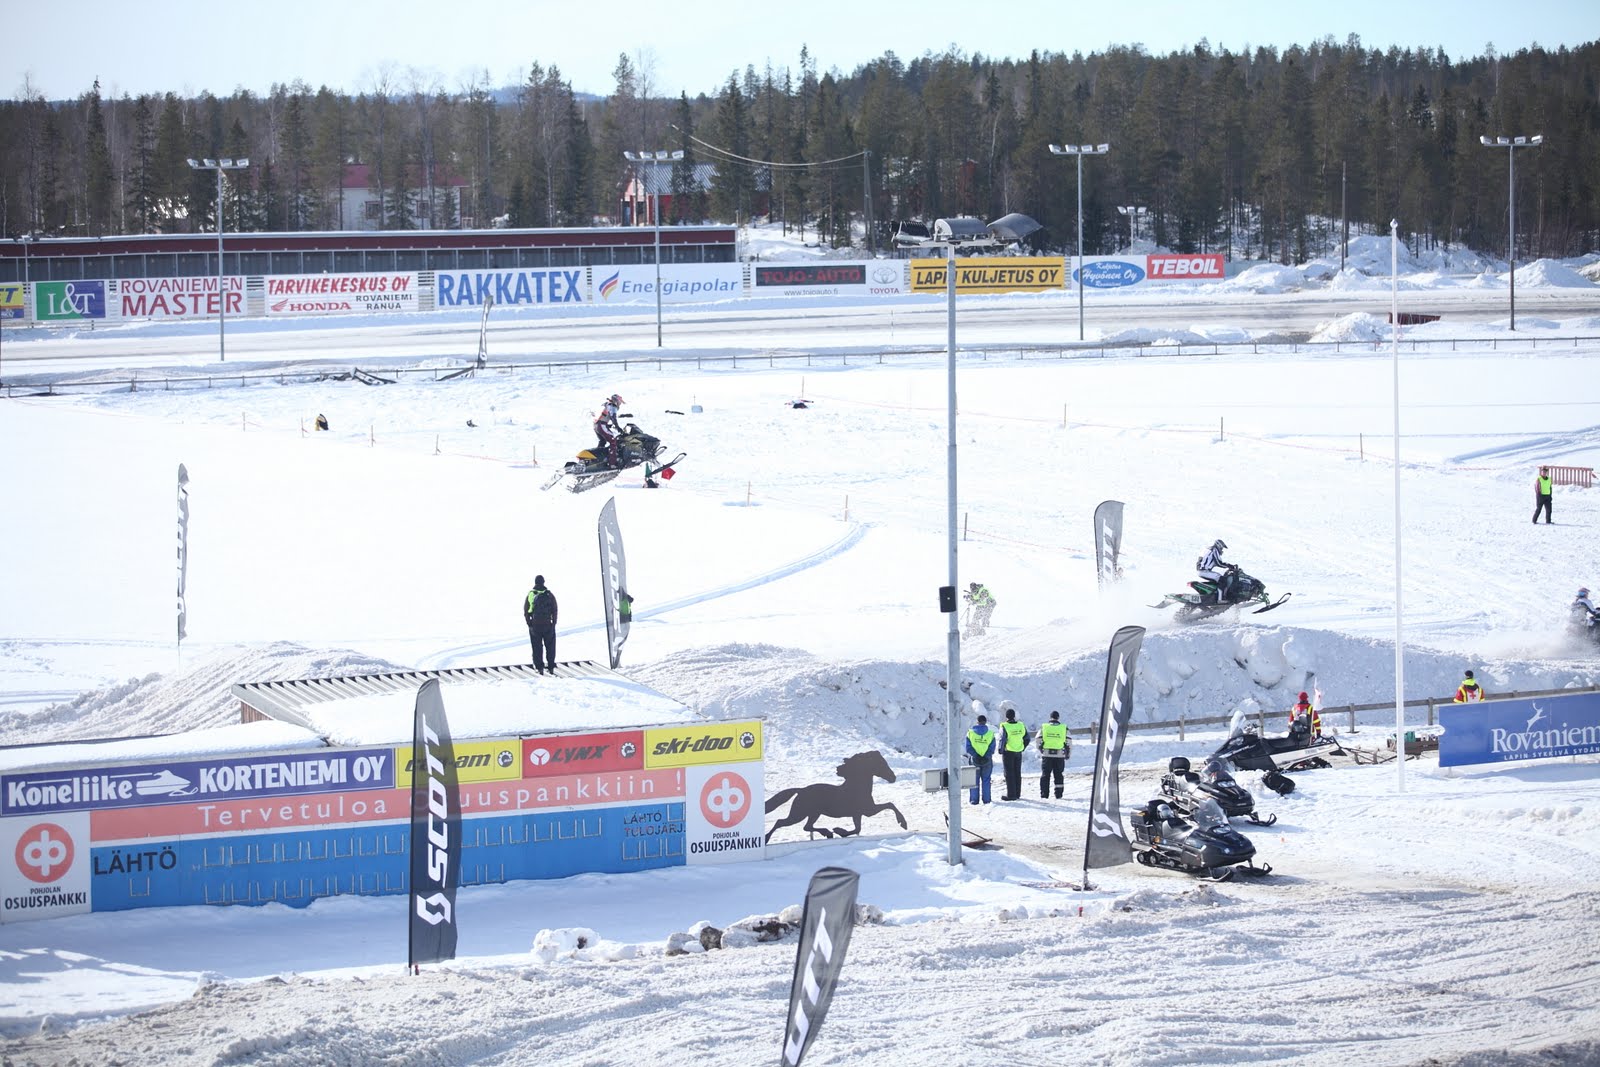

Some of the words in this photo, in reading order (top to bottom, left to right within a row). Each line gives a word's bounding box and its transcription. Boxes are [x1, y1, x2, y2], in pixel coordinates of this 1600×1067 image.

[1123, 269, 1138, 281] Oy
[1151, 258, 1219, 275] TEBOIL
[121, 277, 243, 294] ROVANIEMEN
[268, 277, 387, 295] TARVIKEKESKUS
[392, 275, 410, 291] OY
[961, 269, 1034, 284] KULJETUS
[1038, 269, 1059, 283] OY
[438, 270, 582, 306] RAKKATEX
[622, 278, 738, 296] Energiapolar
[870, 287, 899, 295] TOYOTA
[48, 283, 95, 315] L&T
[122, 292, 243, 317] MASTER
[290, 302, 351, 312] HONDA
[355, 294, 412, 302] ROVANIEMI
[366, 302, 401, 310] RANUA
[551, 743, 611, 764] LYNX
[652, 735, 734, 756] ski-doo
[8, 775, 133, 807] Koneliike
[200, 757, 347, 793] KORTENIEMI
[352, 755, 387, 782] OY
[422, 713, 449, 889] SCOTT
[197, 796, 387, 827] Tervetuloa
[713, 831, 740, 840] POHJOLAN
[690, 836, 762, 854] OSUUSPANKKI
[94, 846, 177, 875] LÄHTÖ
[30, 886, 61, 895] POHJOLAN
[5, 892, 87, 910] OSUUSPANKKI
